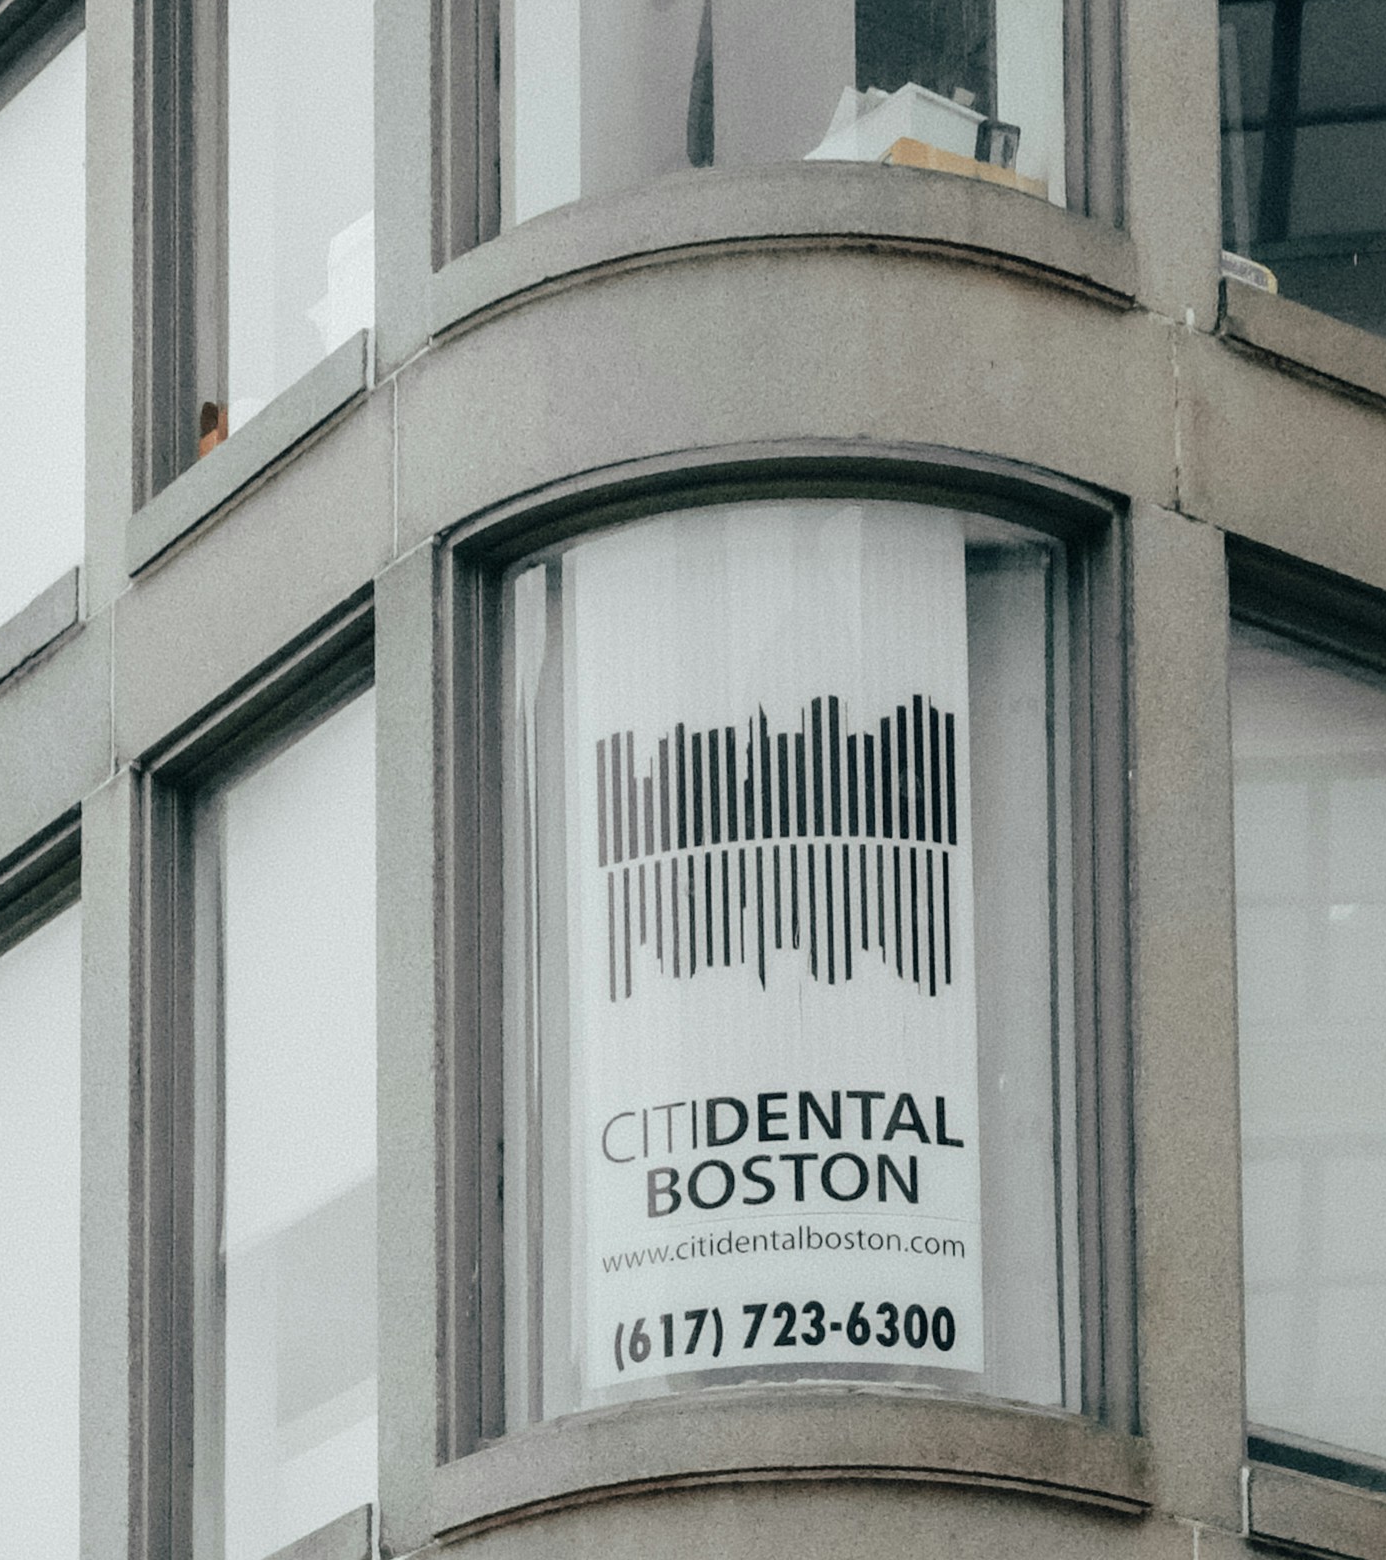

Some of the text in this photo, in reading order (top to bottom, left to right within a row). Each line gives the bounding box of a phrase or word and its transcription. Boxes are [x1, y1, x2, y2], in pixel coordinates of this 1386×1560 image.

[602, 1090, 964, 1163] CITIDENTAL
[646, 1152, 919, 1218] BOSTON
[602, 1226, 966, 1273] www.citidentalboston.com
[614, 1301, 956, 1371] (617) 723-6300
